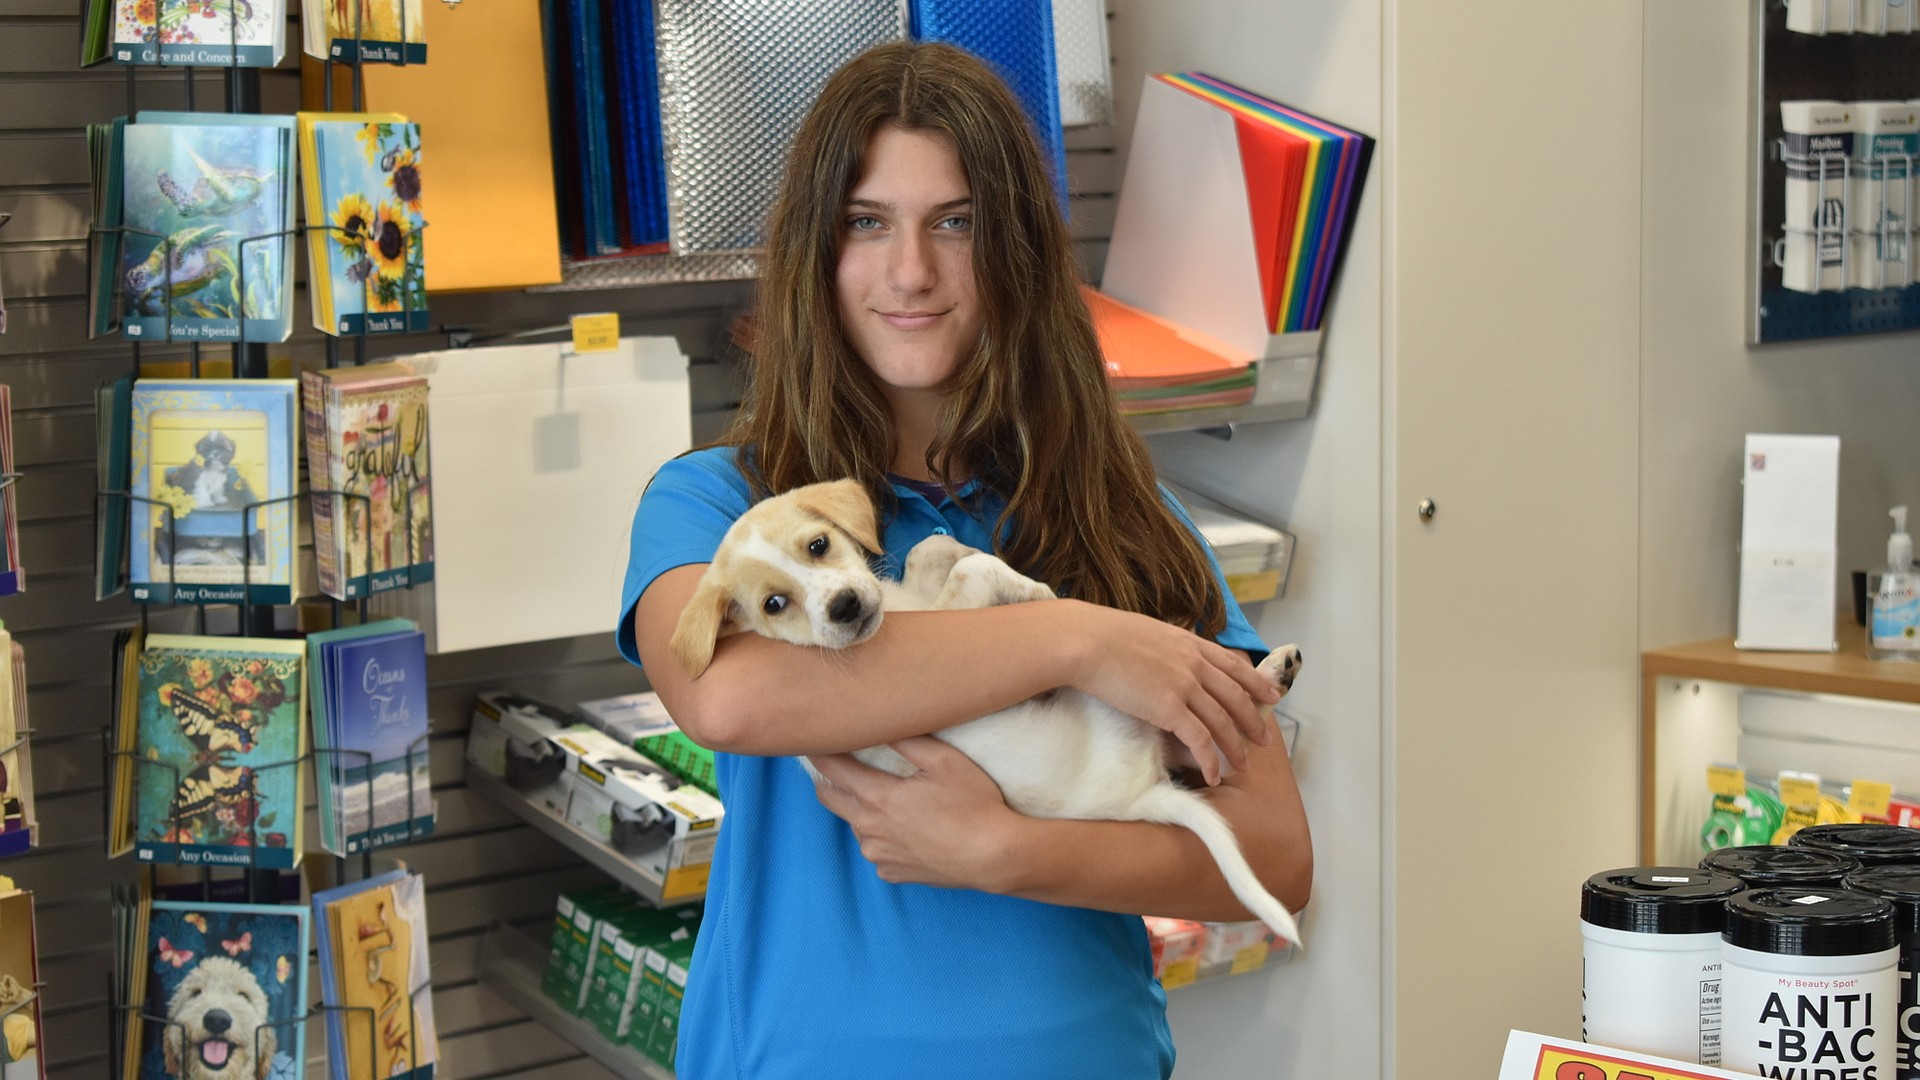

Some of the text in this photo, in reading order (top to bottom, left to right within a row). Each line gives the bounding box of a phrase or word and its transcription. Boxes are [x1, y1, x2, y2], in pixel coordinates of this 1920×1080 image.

[173, 51, 196, 63] and
[198, 51, 246, 64] Concen
[385, 46, 399, 60] You
[1810, 136, 1843, 150] Mailbox
[389, 317, 404, 330] You
[201, 324, 239, 338] Special
[174, 588, 196, 601] Any
[179, 850, 250, 864] Any Occasion
[1703, 982, 1720, 994] Drug
[1778, 978, 1791, 987] My
[1795, 979, 1829, 989] Beauty
[1758, 991, 1872, 1029] ANTI
[1758, 1028, 1875, 1064] -BAC
